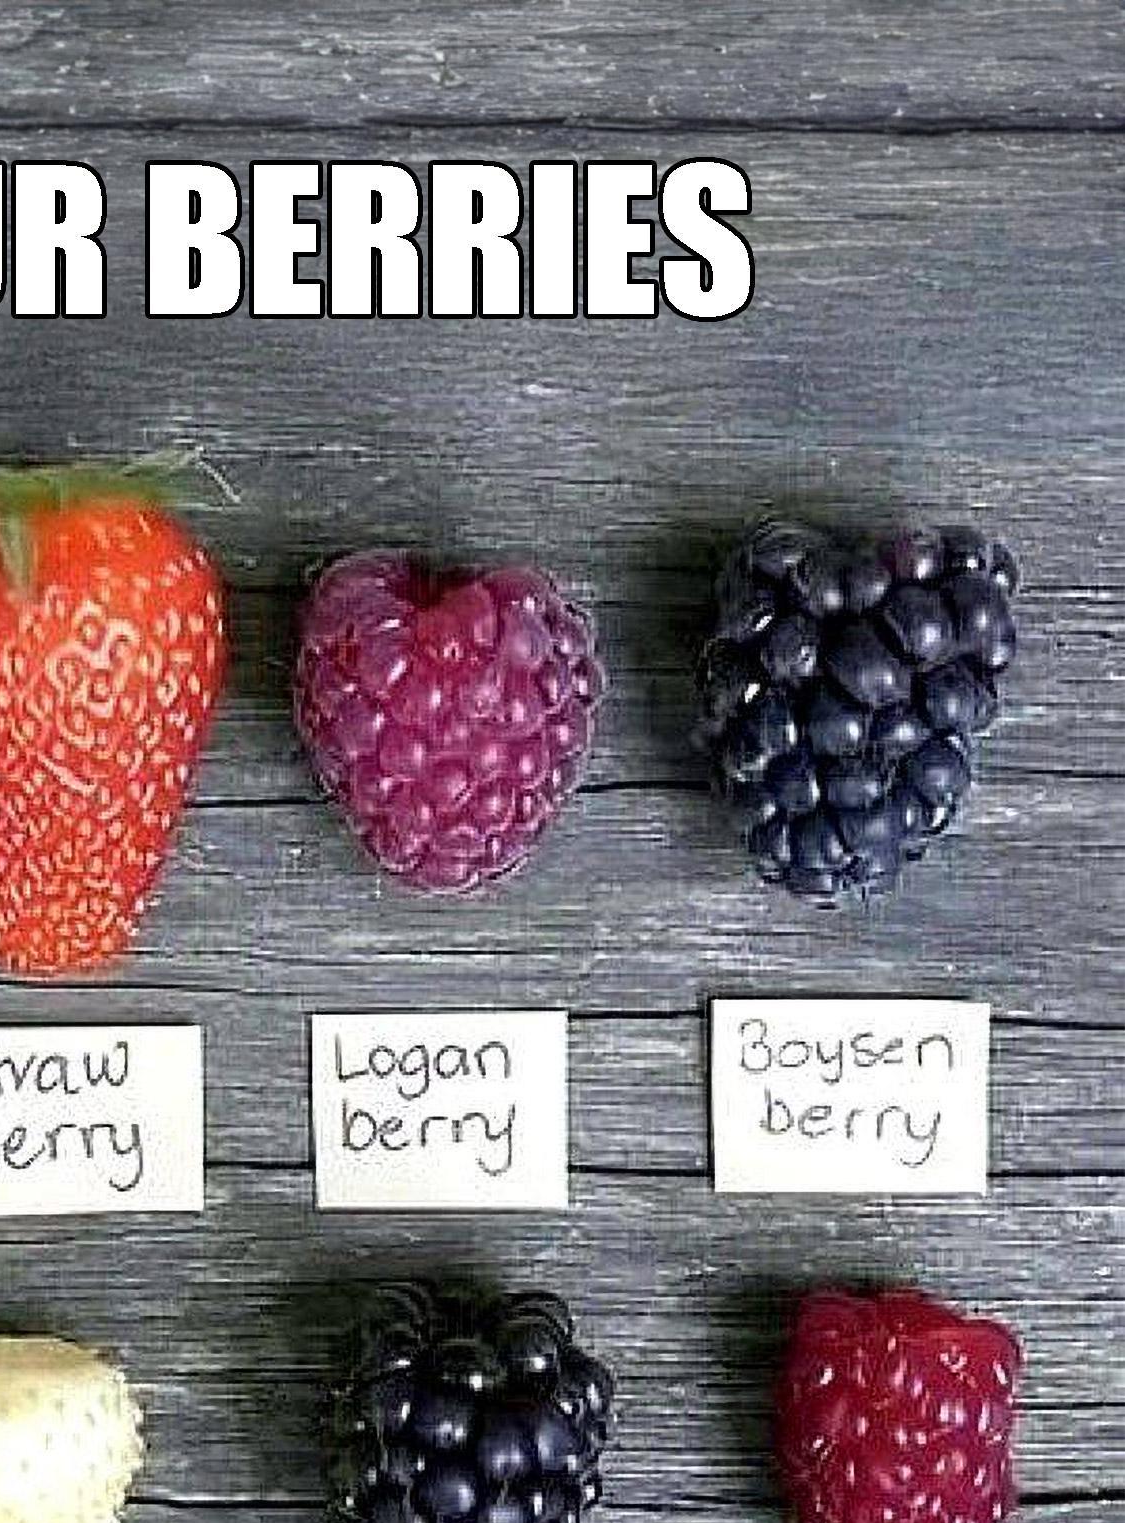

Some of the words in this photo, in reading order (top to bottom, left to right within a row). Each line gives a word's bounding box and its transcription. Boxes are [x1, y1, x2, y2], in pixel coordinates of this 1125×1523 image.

[335, 1037, 510, 1100] Logan
[740, 1019, 953, 1085] Boysen
[342, 1096, 515, 1176] berry
[760, 1086, 940, 1168] berry
